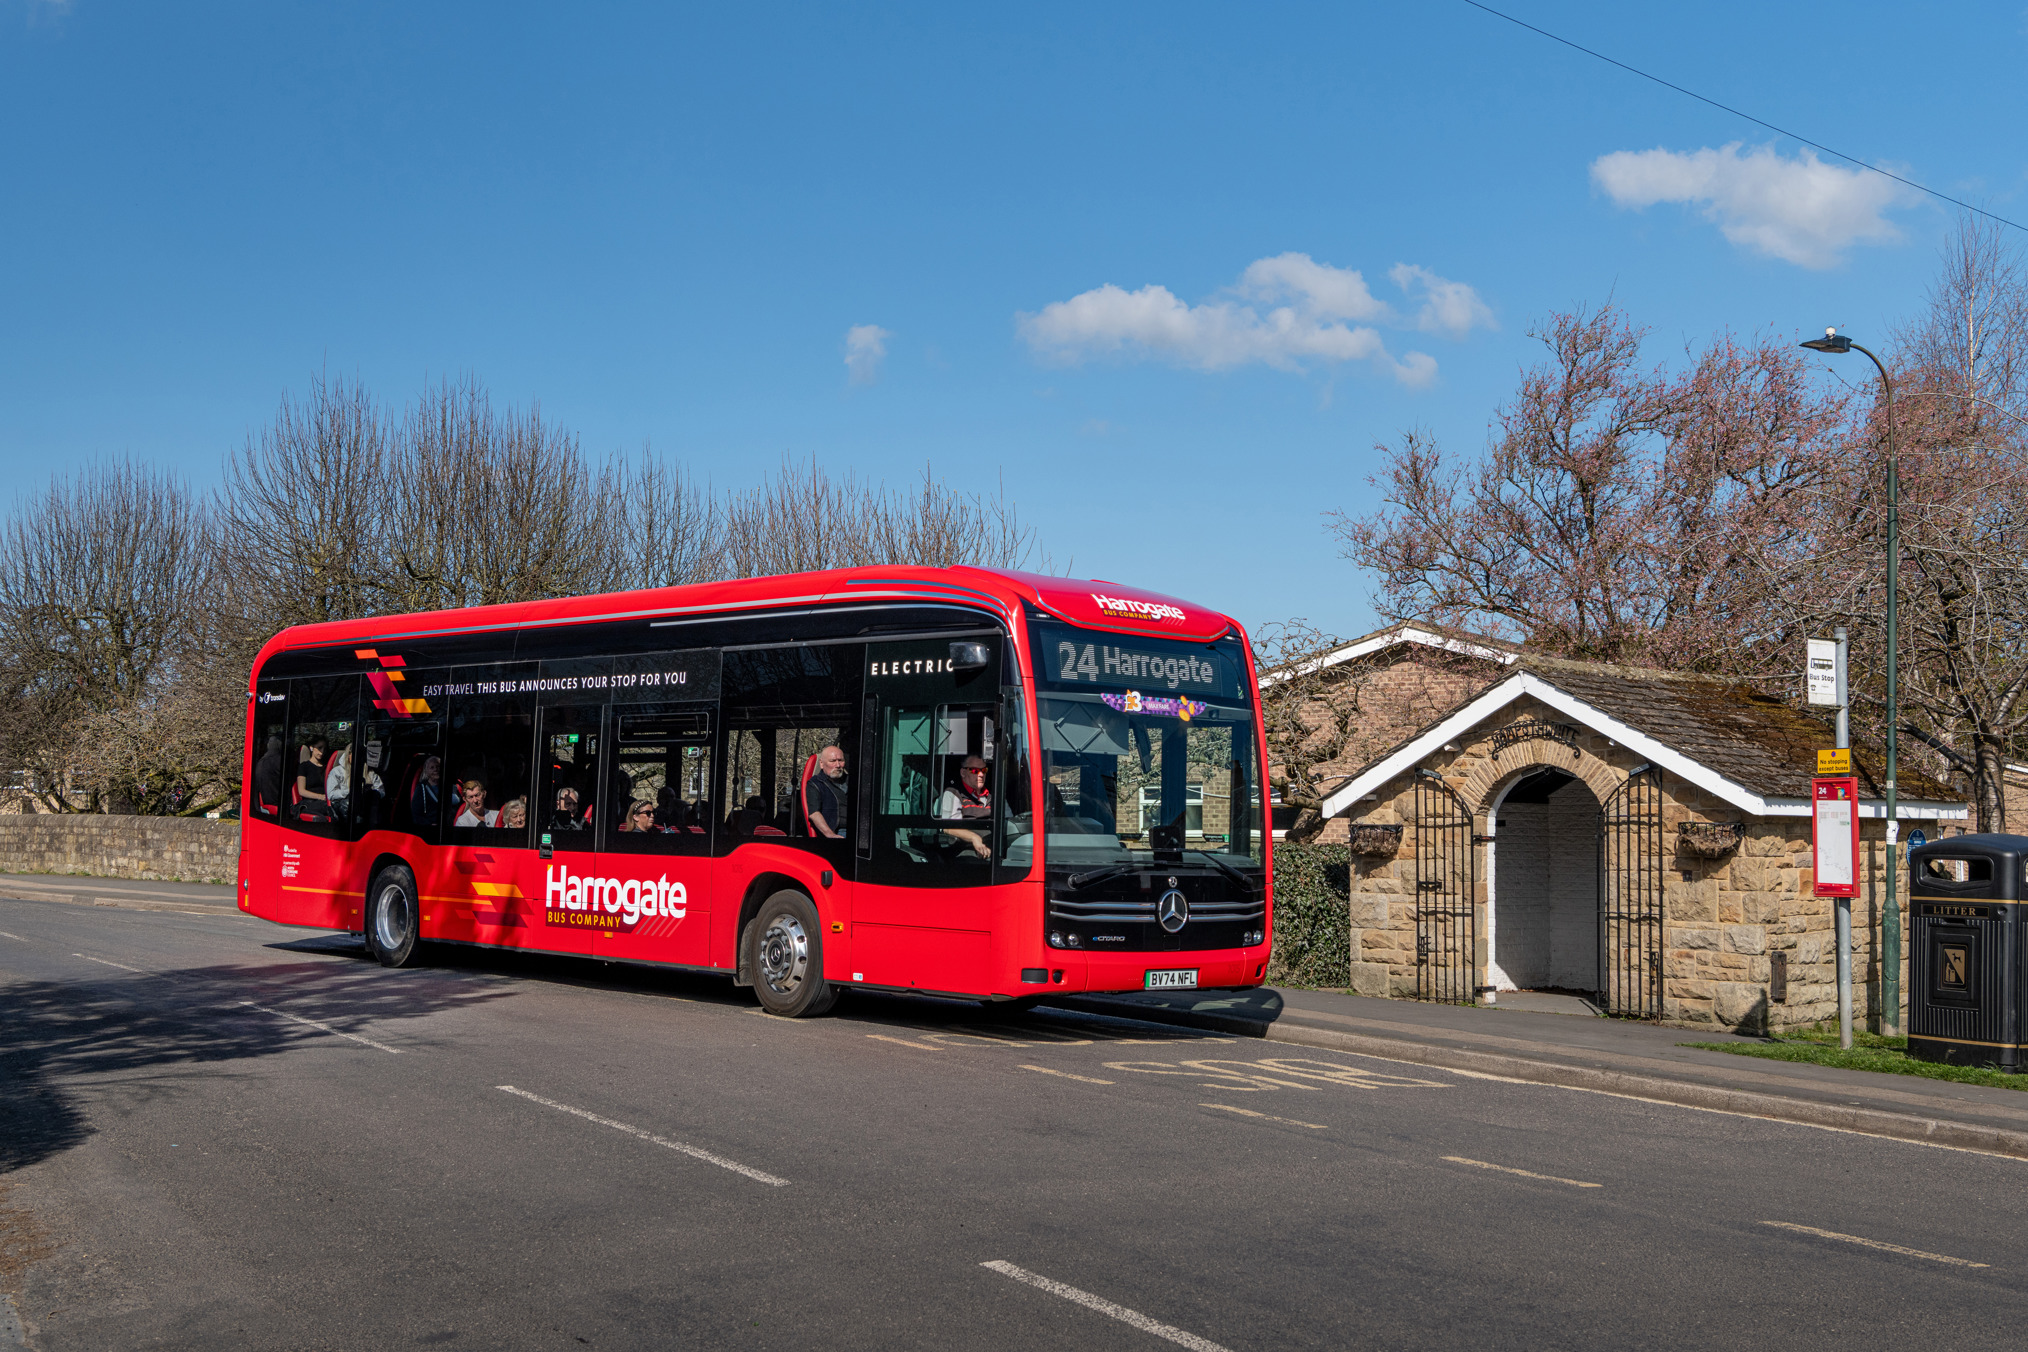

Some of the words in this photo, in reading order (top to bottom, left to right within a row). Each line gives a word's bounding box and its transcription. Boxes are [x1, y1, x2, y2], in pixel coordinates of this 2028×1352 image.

[1090, 594, 1186, 620] Harrogate
[1119, 610, 1152, 620] COMPANY
[871, 658, 954, 676] ELECTRIC
[1058, 641, 1099, 682] 24
[1103, 645, 1213, 689] Harrogate
[423, 684, 442, 696] EASY
[444, 683, 474, 696] TRAVEL
[477, 682, 497, 694] THIS
[500, 681, 517, 692] BUS
[519, 678, 578, 692] ANNOUNCES
[581, 676, 608, 689] YOUR
[610, 675, 637, 687] STOP
[640, 674, 660, 686] FOR
[664, 672, 686, 684] YOU
[1822, 674, 1834, 683] Stop
[1124, 690, 1142, 712] £3
[546, 864, 687, 924] Harrogate
[548, 912, 566, 924] BUS
[570, 913, 621, 928] COMPANY
[1933, 906, 1976, 916] LITTER
[1151, 972, 1176, 986] BV74
[1178, 972, 1195, 984] NFL
[1102, 1058, 1457, 1092] BUS
